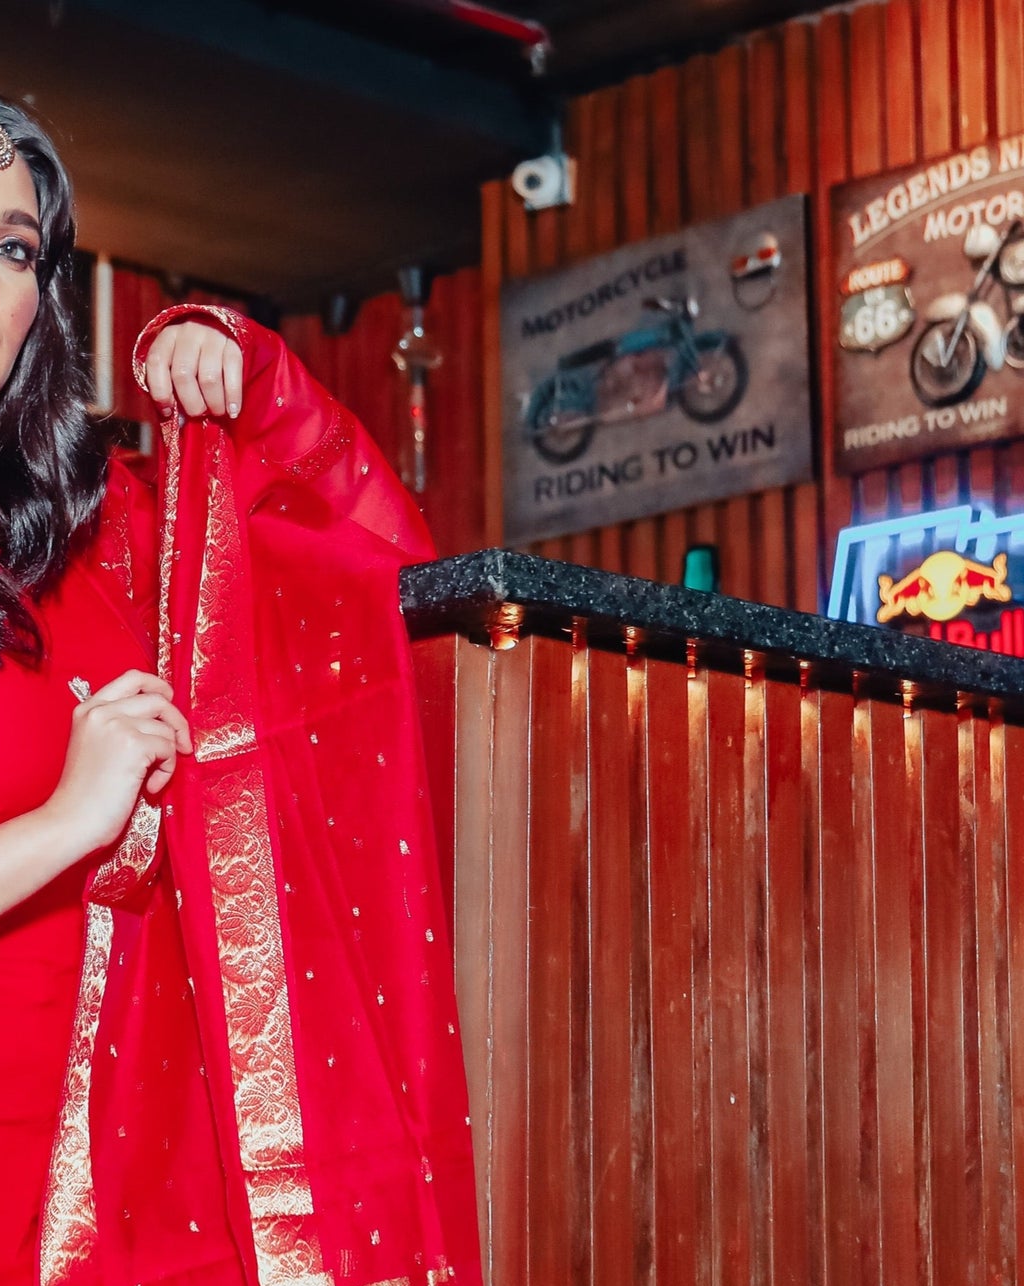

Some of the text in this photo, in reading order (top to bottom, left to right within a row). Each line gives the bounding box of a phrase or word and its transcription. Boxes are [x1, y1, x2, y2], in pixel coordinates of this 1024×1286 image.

[849, 136, 1024, 246] LEGENDS N
[924, 191, 1024, 242] MOTOR
[522, 250, 687, 336] MOTORCYCLE
[848, 258, 903, 293] ROUTE
[855, 299, 897, 345] 66
[844, 415, 920, 450] RIDING
[924, 407, 955, 432] TO
[959, 396, 1008, 424] WIN
[533, 422, 775, 501] RIDING TO WIN
